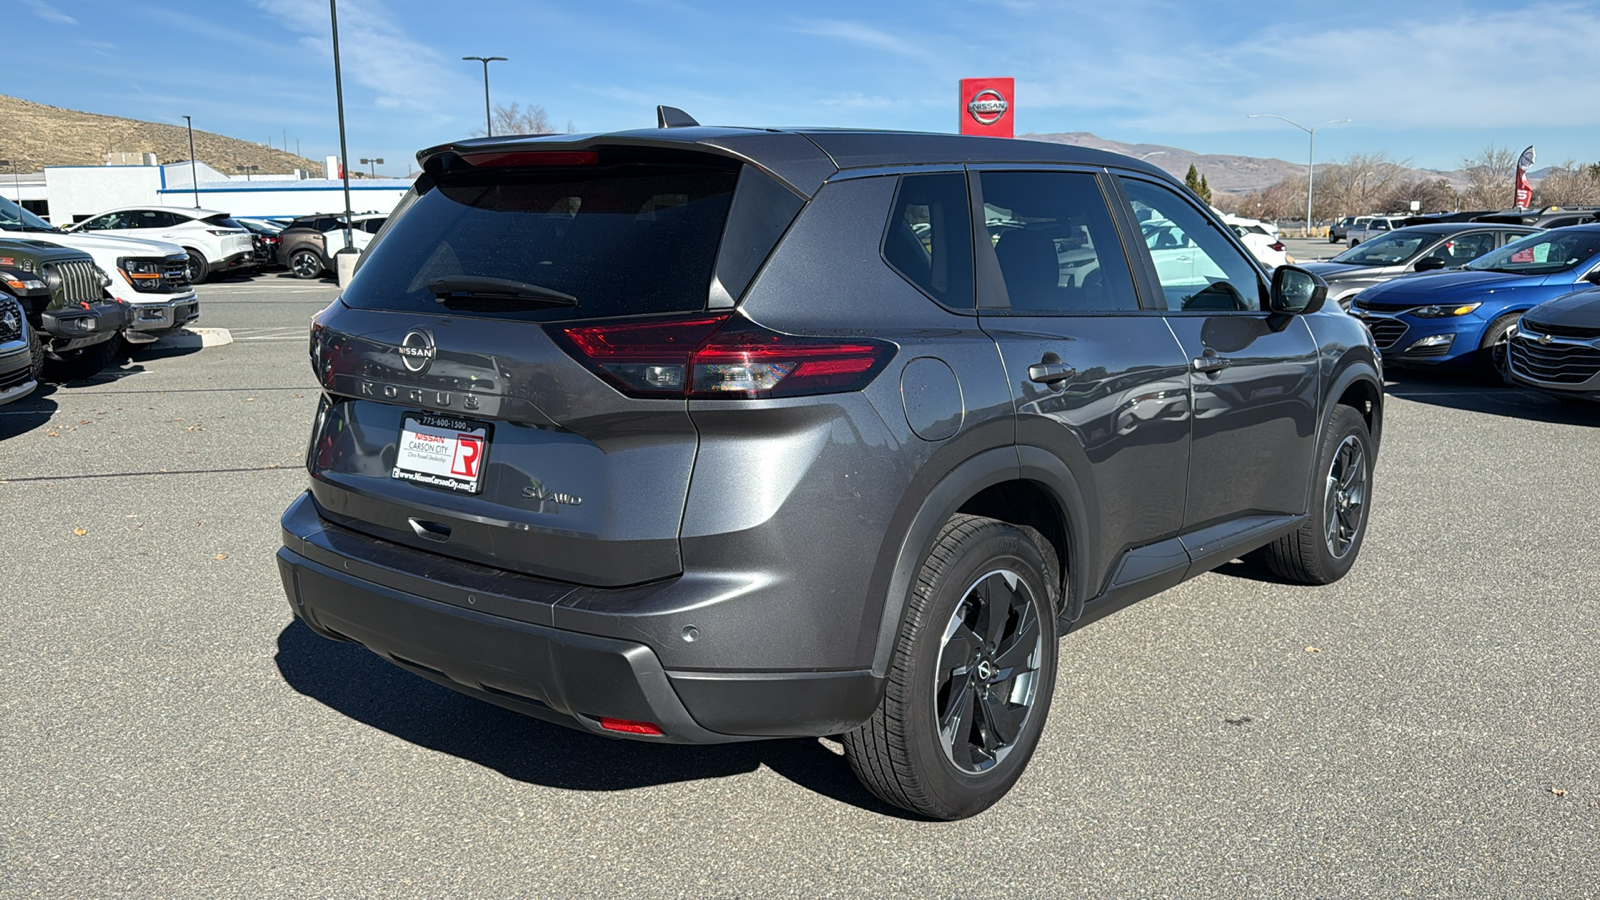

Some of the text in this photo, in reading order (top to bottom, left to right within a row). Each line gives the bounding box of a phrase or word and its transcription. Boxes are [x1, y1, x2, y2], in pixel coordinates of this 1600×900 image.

[972, 102, 1005, 110] NISSAN
[399, 346, 432, 357] NISSAN
[361, 382, 479, 410] ROGUE
[422, 416, 467, 430] 775-600-1500
[415, 433, 446, 444] NISSAN
[409, 441, 449, 454] CARSON CITY
[399, 471, 470, 490] www.NissanCarsonCity.com
[521, 485, 553, 500] SV
